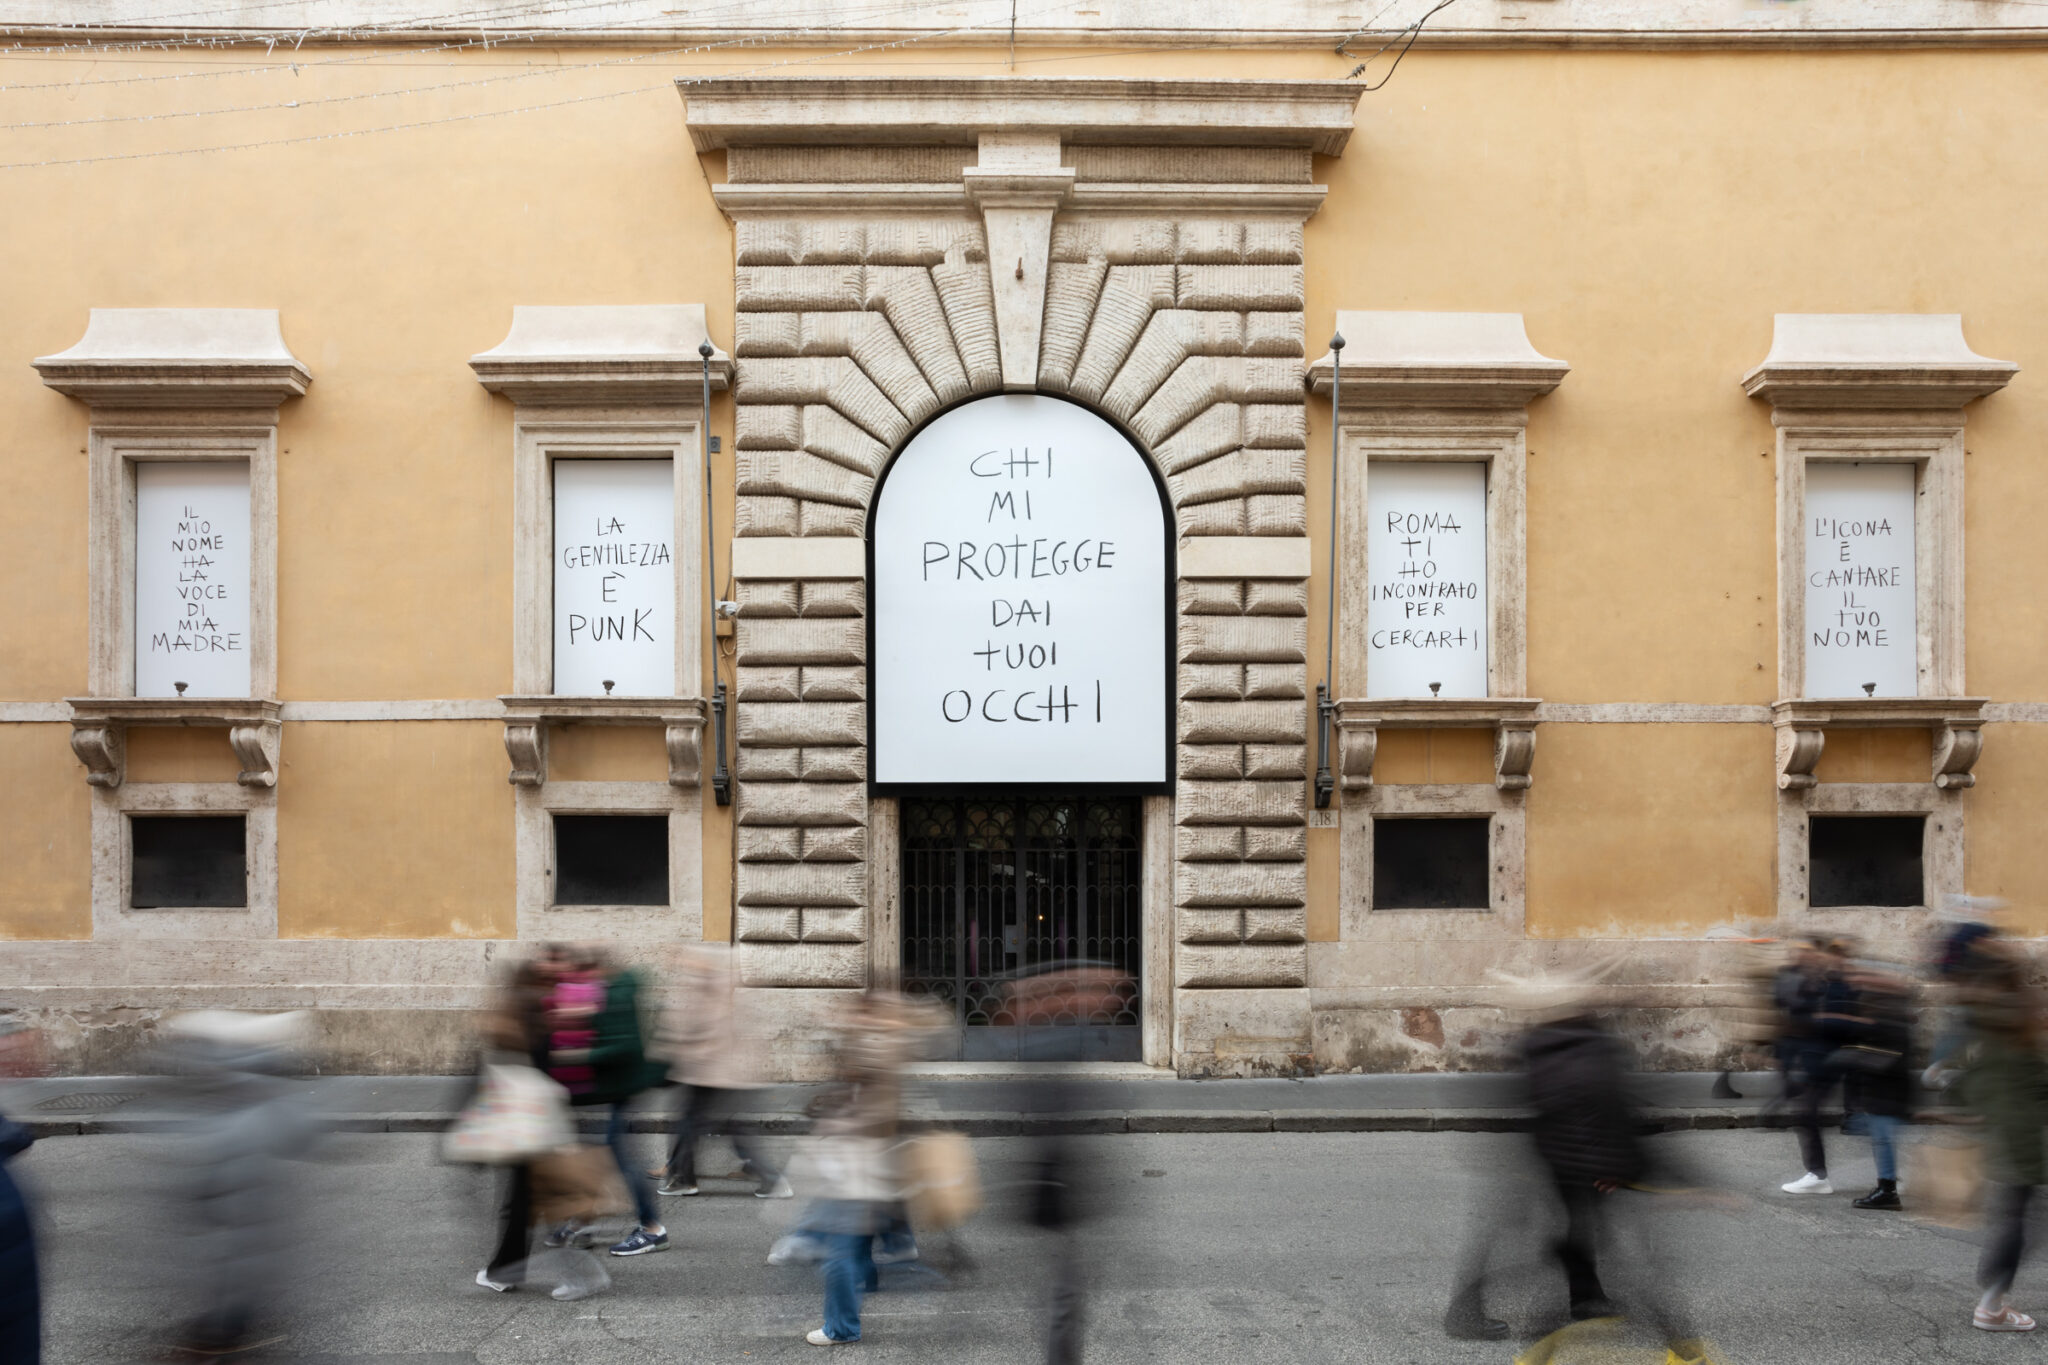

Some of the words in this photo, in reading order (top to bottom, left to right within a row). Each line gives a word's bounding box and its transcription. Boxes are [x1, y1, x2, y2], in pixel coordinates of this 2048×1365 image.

[970, 447, 1052, 479] CHI
[184, 505, 199, 519] IL
[988, 490, 1031, 523] MI
[177, 521, 211, 534] MIO
[597, 516, 626, 536] LA
[1387, 511, 1462, 534] ROMA
[1815, 518, 1892, 540] L'ICONA
[172, 535, 224, 552] NOME
[181, 554, 215, 569] HA
[1398, 560, 1437, 579] HO
[179, 569, 208, 582] LA
[176, 584, 228, 601] VOCE
[602, 571, 626, 603] È
[186, 602, 206, 617] DI
[1843, 591, 1867, 609] IL
[991, 599, 1051, 628] DAI
[1405, 601, 1446, 619] PER
[178, 617, 220, 632] MIA
[569, 607, 655, 646] PUNK
[152, 632, 243, 654] MADRE
[1813, 627, 1890, 648] NOME
[942, 679, 1102, 724] OCCHI
